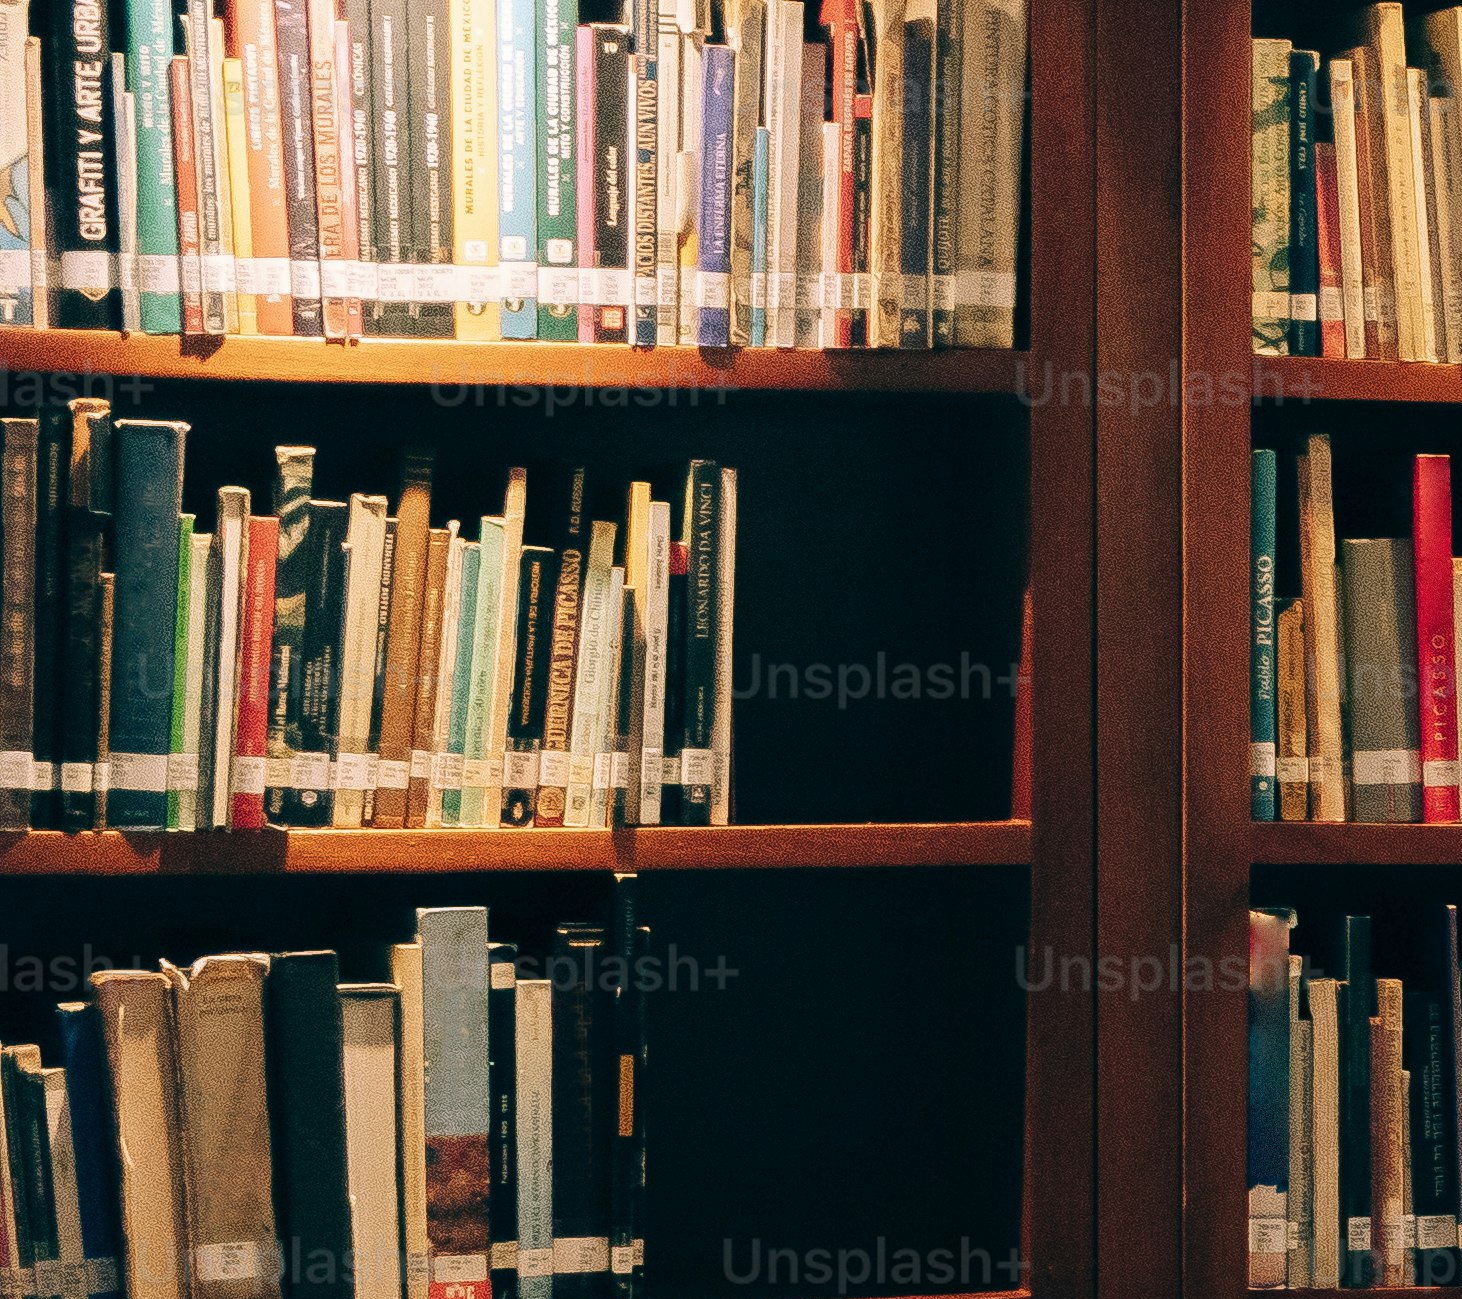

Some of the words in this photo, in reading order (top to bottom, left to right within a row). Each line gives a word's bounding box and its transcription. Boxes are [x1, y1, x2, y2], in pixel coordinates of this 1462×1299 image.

[74, 61, 102, 122] ARTE
[314, 60, 334, 146] MURALES
[637, 79, 657, 120] VIVOS
[76, 130, 102, 144] Y
[318, 153, 336, 187] LOS
[76, 151, 106, 241] GRAFITI
[320, 193, 339, 216] DE
[699, 482, 713, 528] VINCI
[699, 530, 712, 552] DA
[554, 548, 582, 626] PICASSO
[695, 554, 711, 639] LEONARDO
[1255, 554, 1274, 647] PICASSO
[552, 628, 574, 655] DE
